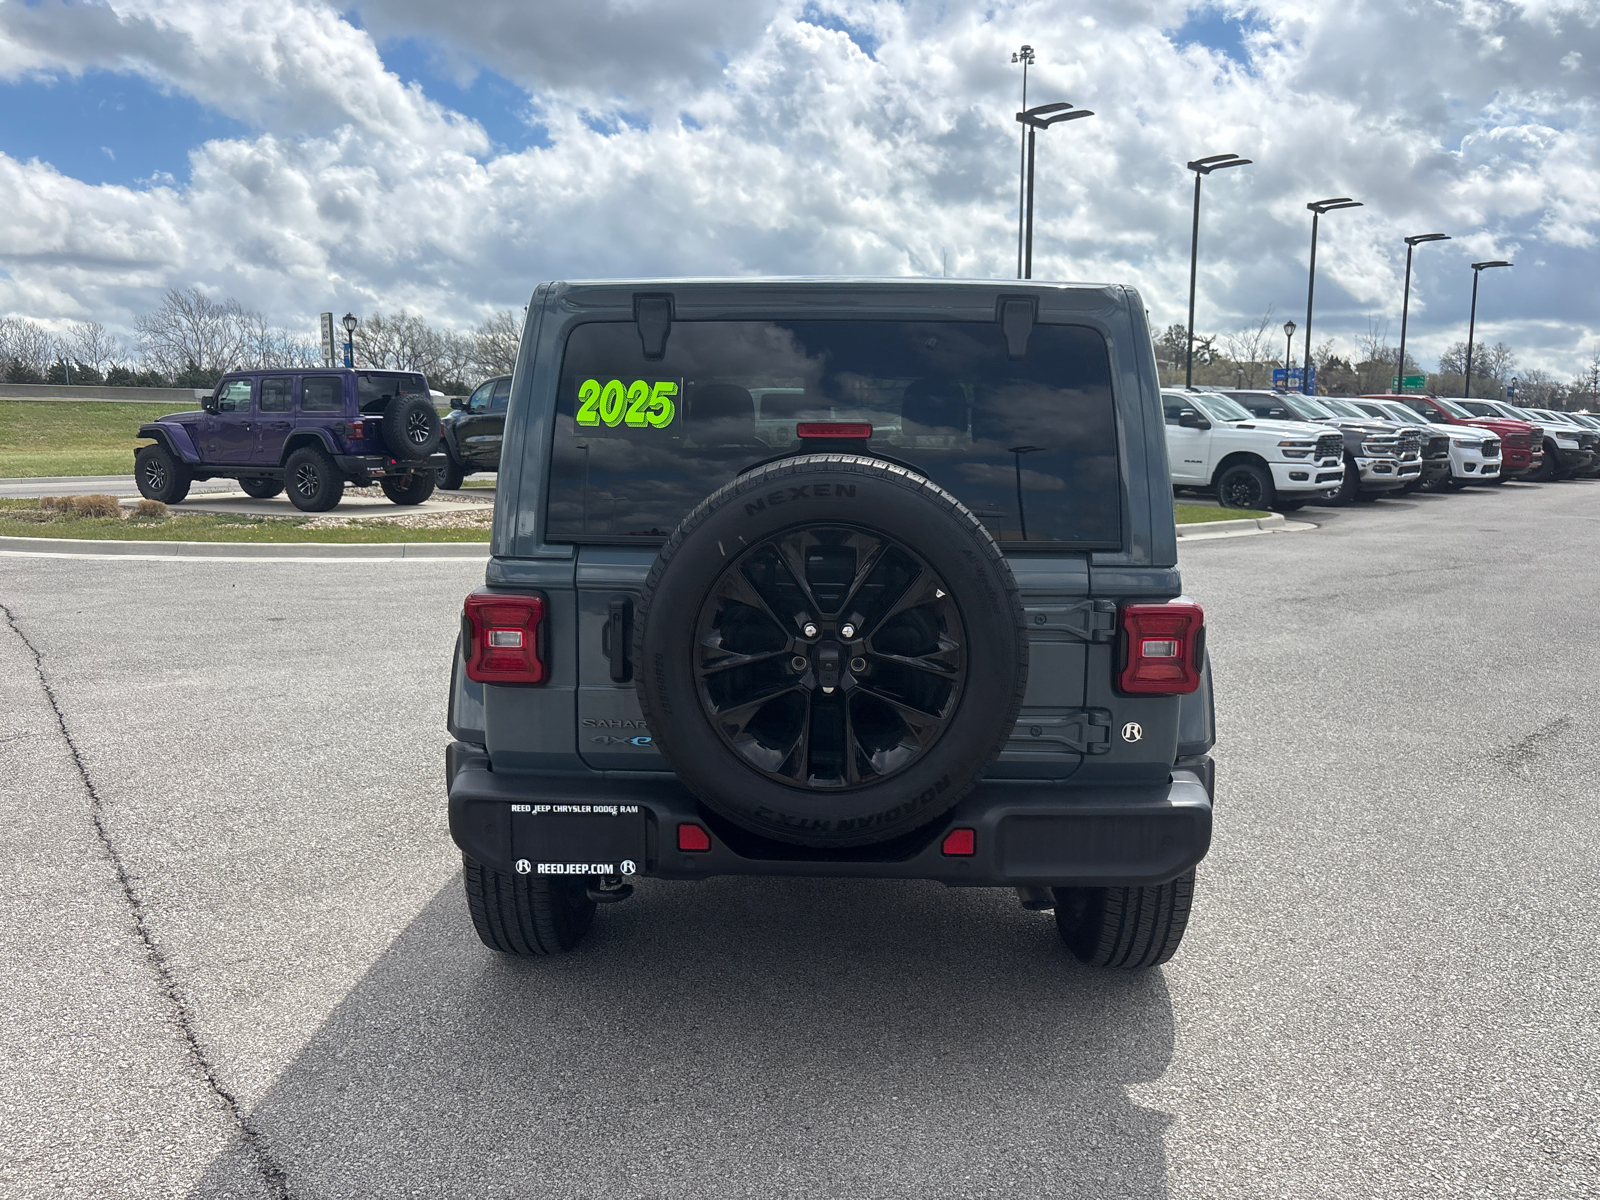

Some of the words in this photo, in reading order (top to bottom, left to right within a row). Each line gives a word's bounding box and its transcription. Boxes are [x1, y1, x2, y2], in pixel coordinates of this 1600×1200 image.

[576, 379, 678, 429] 2025
[744, 483, 856, 516] NEXEN
[511, 804, 531, 813] REED
[533, 804, 551, 814] JEEP
[552, 805, 592, 813] CHRYSLER
[593, 805, 618, 814] DODGE
[620, 805, 638, 813] RAM
[836, 774, 952, 832] ROADIAN
[537, 863, 614, 875] REEDJEEP.COM
